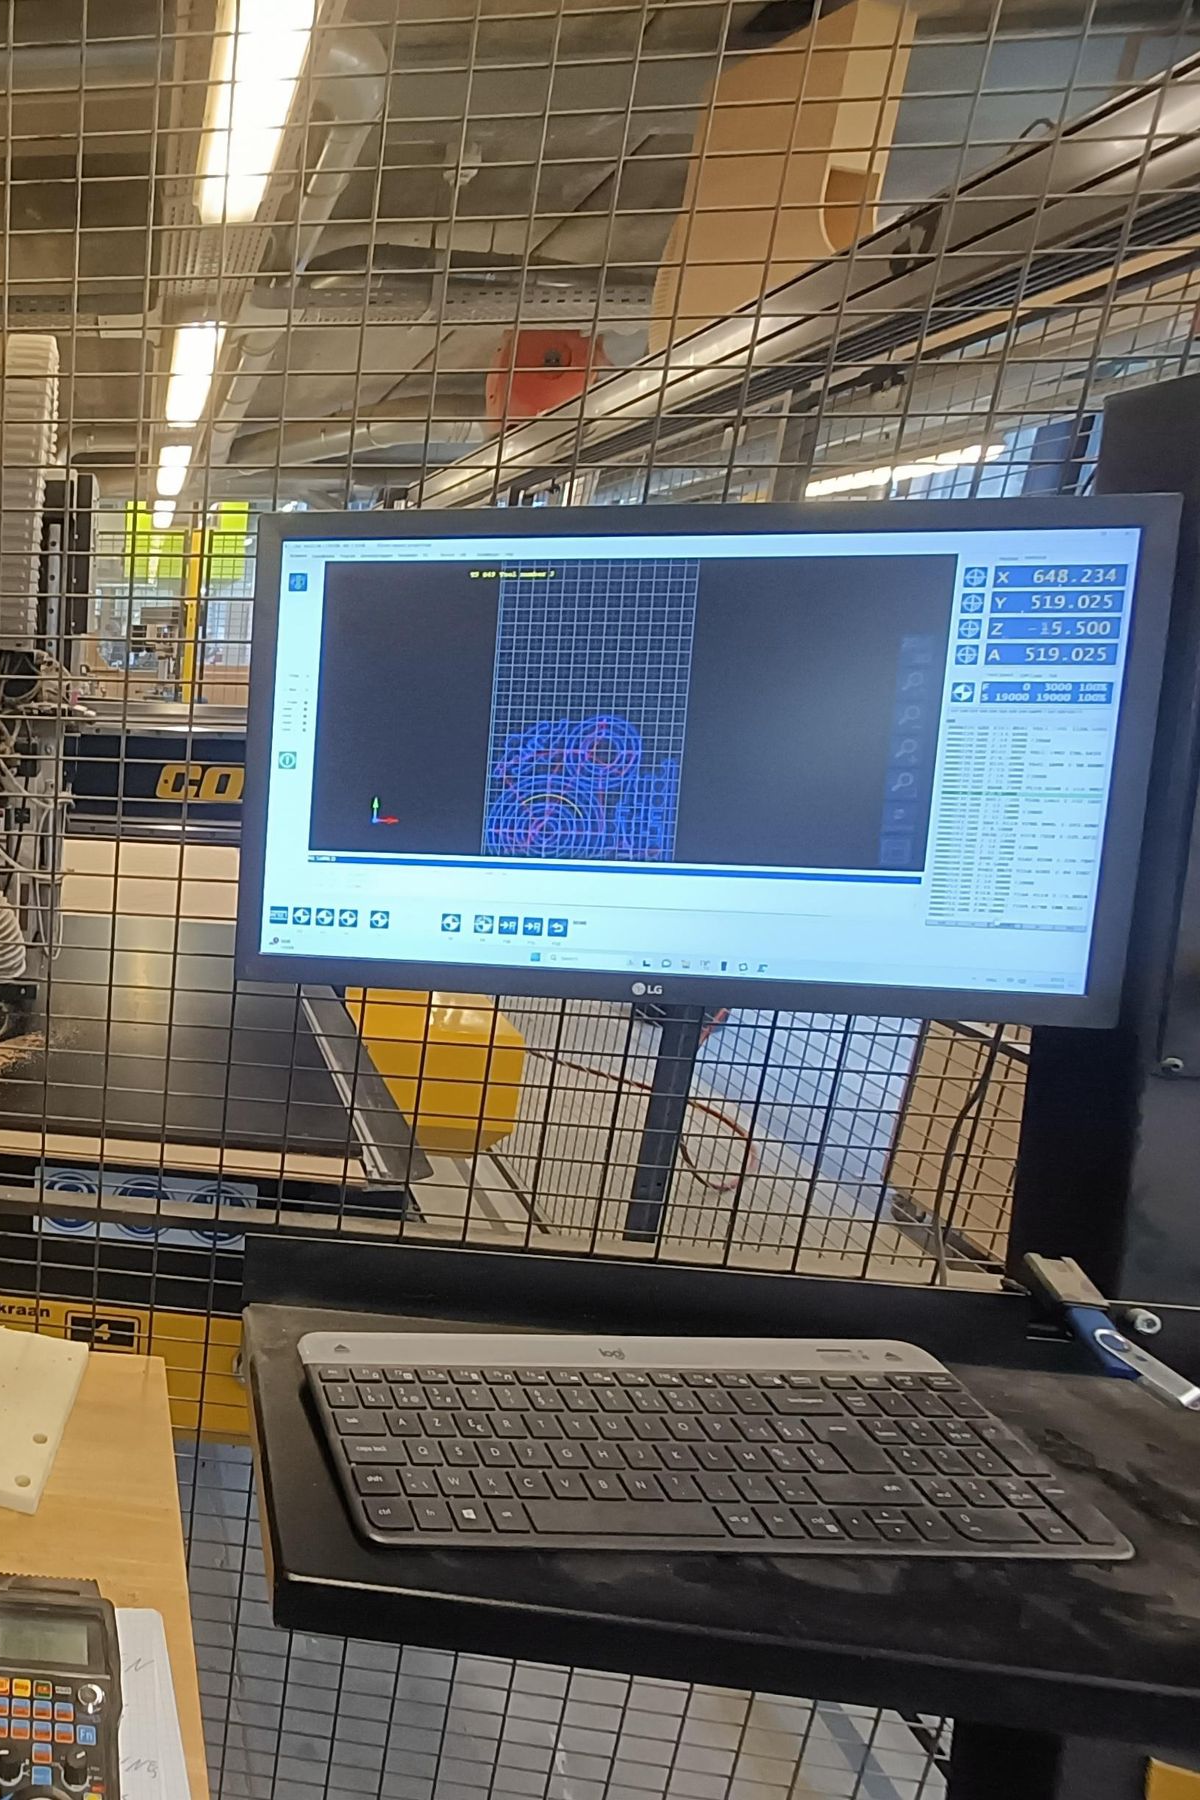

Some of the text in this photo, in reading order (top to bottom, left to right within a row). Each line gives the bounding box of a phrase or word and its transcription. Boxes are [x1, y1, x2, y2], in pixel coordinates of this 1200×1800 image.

[996, 568, 1117, 584] X 648.234
[994, 594, 1114, 609] Y 519.025
[990, 623, 1004, 636] Z
[987, 647, 1108, 662] A 519.025
[995, 693, 1030, 702] 19000
[1036, 693, 1072, 702] 19000
[80, 1728, 94, 1740] Fn
